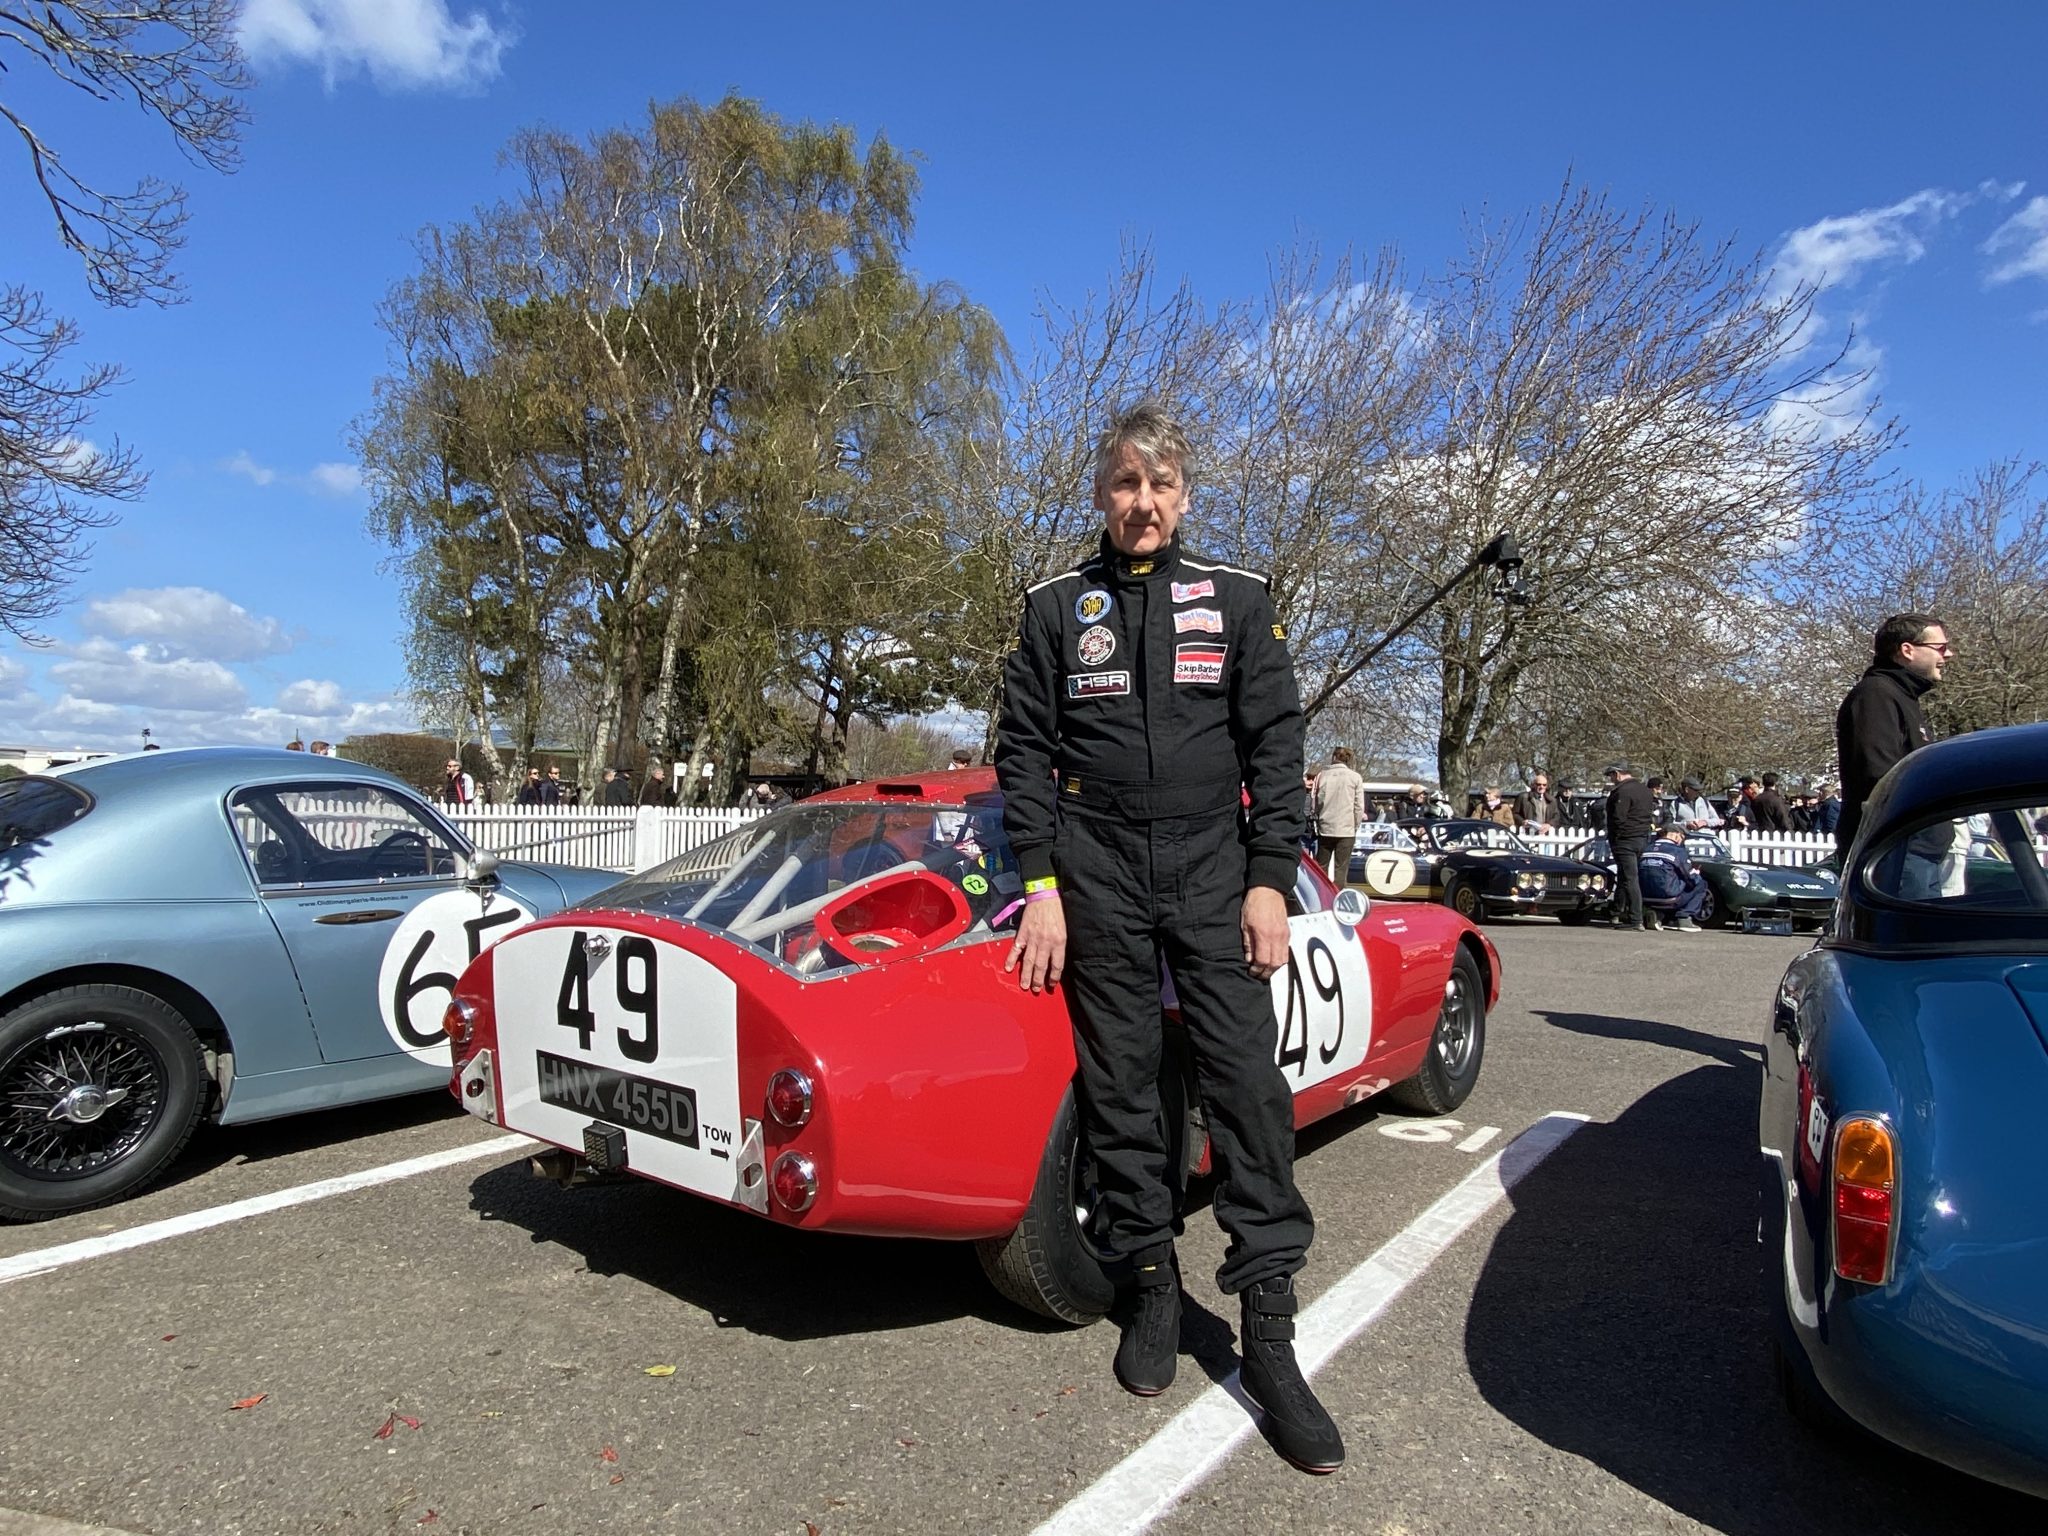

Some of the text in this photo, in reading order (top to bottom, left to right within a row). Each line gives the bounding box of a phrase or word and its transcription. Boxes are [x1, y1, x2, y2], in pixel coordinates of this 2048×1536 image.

[1177, 664, 1221, 674] Skip Barber
[1077, 674, 1126, 690] HSR
[1380, 859, 1400, 885] 7
[966, 879, 984, 891] T2
[557, 931, 657, 1064] 49
[1278, 936, 1344, 1078] 49
[540, 1056, 695, 1138] HNX 455D
[702, 1124, 732, 1146] TOW
